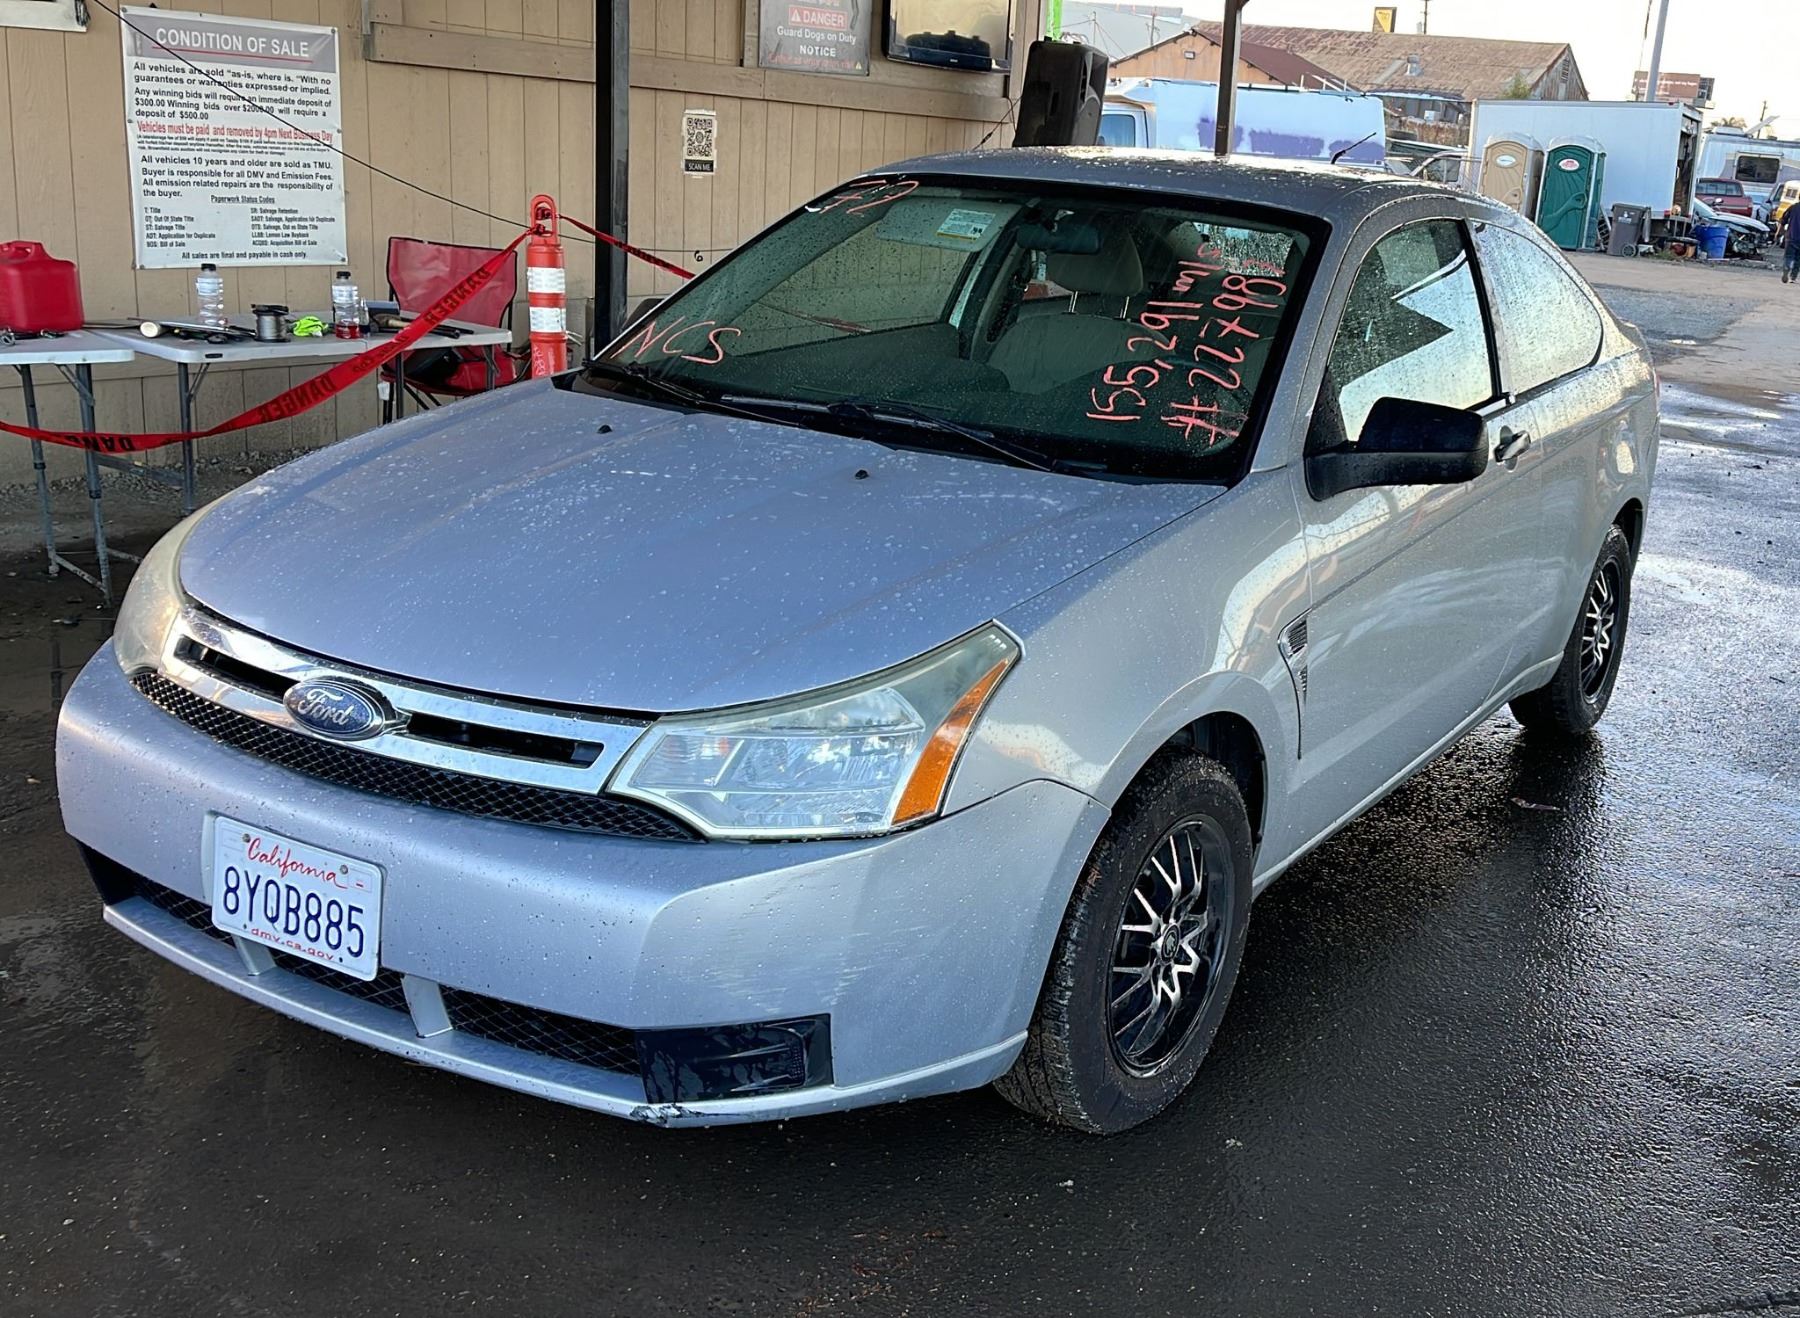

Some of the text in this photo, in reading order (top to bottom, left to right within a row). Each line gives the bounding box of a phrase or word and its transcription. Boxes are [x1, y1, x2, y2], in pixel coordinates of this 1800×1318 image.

[803, 10, 844, 27] DANGER
[156, 27, 309, 57] CONDITION OF SALE
[777, 25, 802, 37] Guard
[805, 29, 824, 42] Dogs
[839, 33, 856, 45] Duty
[800, 45, 836, 57] NOTICE
[134, 62, 145, 71] All
[148, 64, 186, 74] vehicles
[189, 67, 203, 75] are
[206, 68, 224, 77] sold
[257, 73, 282, 81] where
[134, 74, 184, 84] guarantees
[198, 78, 243, 88] warranties
[245, 82, 288, 92] expressed
[134, 87, 150, 97] Any
[152, 89, 184, 99] winning
[185, 90, 203, 99] bids
[204, 92, 218, 100] will
[219, 93, 245, 103] require
[258, 95, 295, 105] immediate
[297, 98, 323, 107] deposit
[135, 98, 165, 107] $300.00
[167, 99, 199, 110] Winning
[203, 101, 220, 110] bids
[278, 107, 290, 115] will
[294, 108, 318, 117] require
[135, 109, 209, 120] deposit of $500.00
[137, 120, 166, 133] Vehicles
[167, 123, 185, 134] must
[185, 123, 194, 134] be
[195, 124, 210, 135] paid
[213, 124, 225, 136] and
[226, 125, 253, 138] removed
[255, 127, 262, 140] by
[279, 128, 292, 139] Next
[322, 130, 332, 143] Day
[141, 155, 152, 163] All
[154, 155, 190, 165] vehicles
[193, 157, 203, 165] 10
[205, 158, 228, 166] years
[230, 158, 245, 166] and
[247, 159, 268, 167] older
[689, 163, 701, 171] SCAN
[142, 168, 165, 177] Buyer
[167, 168, 175, 176] is
[176, 169, 222, 178] responsible
[223, 169, 234, 178] for
[236, 170, 245, 178] all
[266, 171, 280, 179] and
[281, 172, 314, 180] Emission
[143, 178, 153, 186] All
[155, 179, 191, 187] emission
[193, 180, 219, 188] related
[221, 180, 247, 189] repairs
[278, 182, 324, 191] responsibility
[143, 189, 182, 198] the buyer.
[248, 251, 271, 260] payable
[610, 315, 741, 364] NCS
[1086, 300, 1203, 421] 155,291
[297, 687, 354, 729] Ford
[248, 837, 348, 889] California
[223, 866, 365, 958] 8YQB885
[251, 928, 334, 961] dmv.ca.gov
